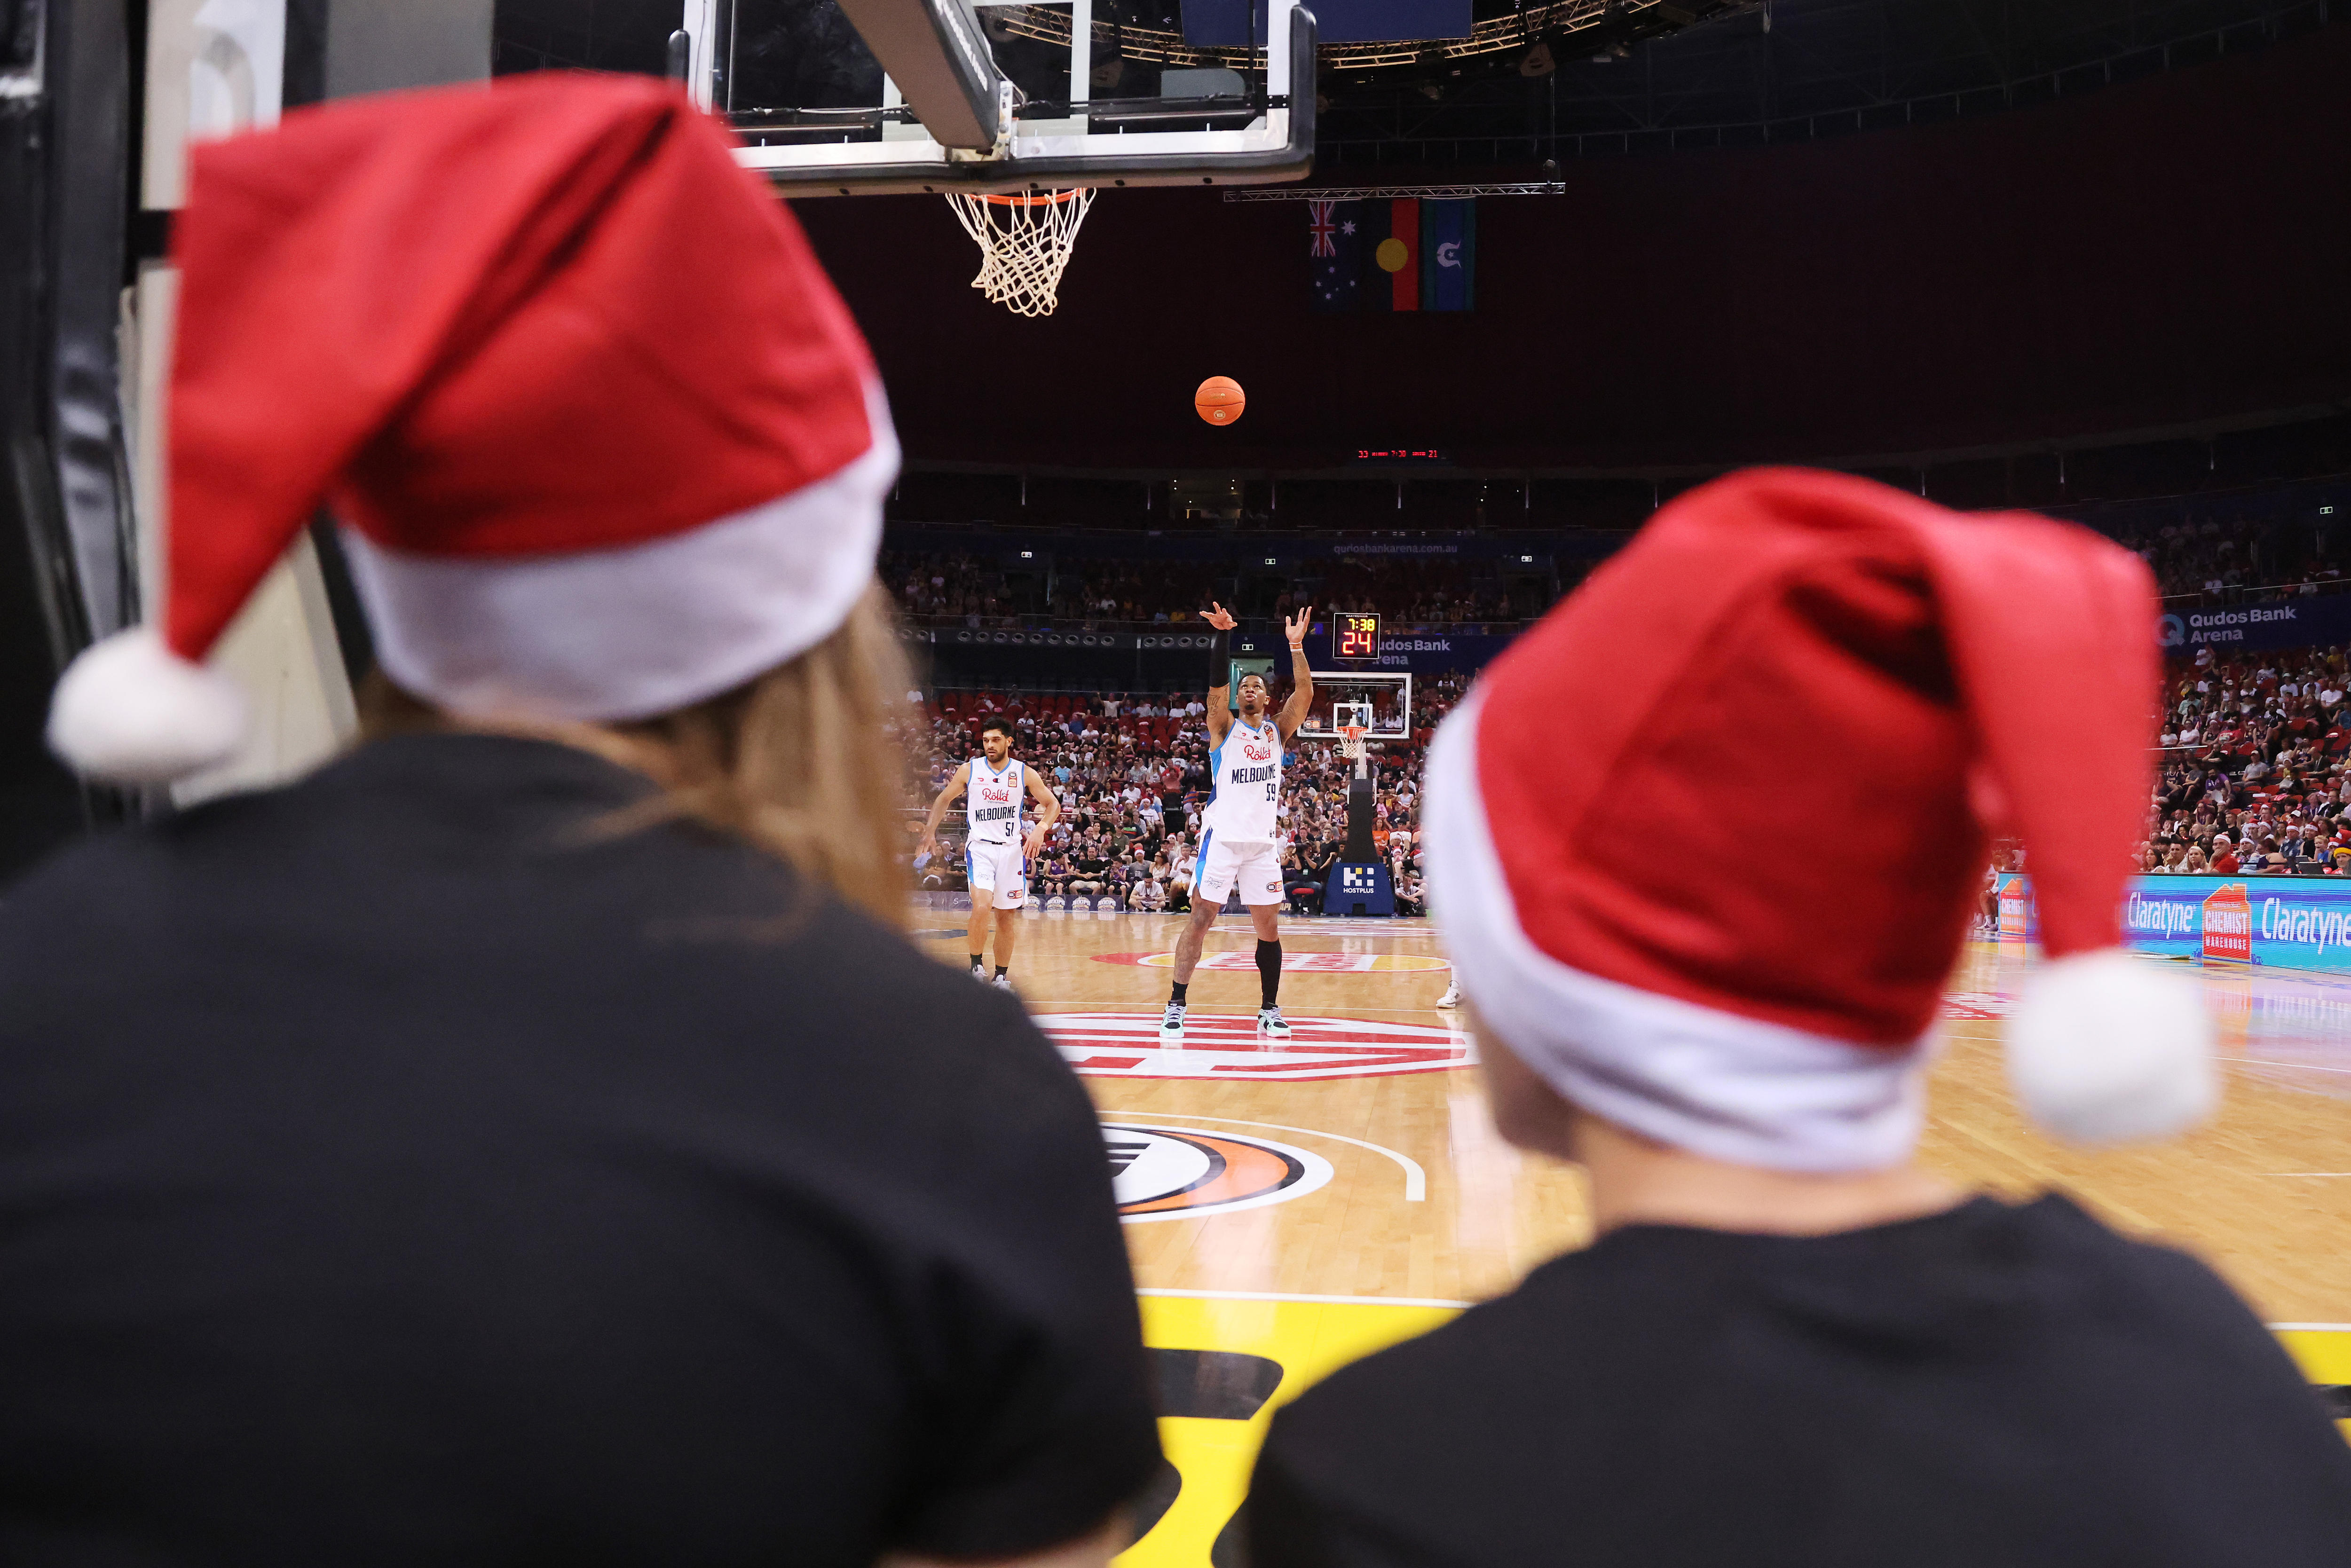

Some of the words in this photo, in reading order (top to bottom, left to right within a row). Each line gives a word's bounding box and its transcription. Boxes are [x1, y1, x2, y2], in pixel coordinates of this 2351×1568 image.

[1334, 544, 1457, 555] qudosbankarena.com.au
[2190, 611, 2248, 627] Qudos
[2250, 606, 2297, 622] Bank
[1348, 618, 1375, 632] 7:38
[1342, 632, 1372, 654] 24
[2190, 629, 2243, 643] Arena
[1380, 639, 1412, 651] udos
[1414, 639, 1451, 651] Bank
[1266, 783, 1276, 801] 59
[975, 806, 1016, 822] MELBOURNE
[1005, 822, 1014, 837] 51
[2002, 898, 2024, 914] CHEMIST
[2128, 891, 2194, 939] Claratyne
[2205, 910, 2248, 935] CHEMIST
[2262, 897, 2351, 955] Claratyne
[2205, 935, 2247, 950] WAREHOUSE
